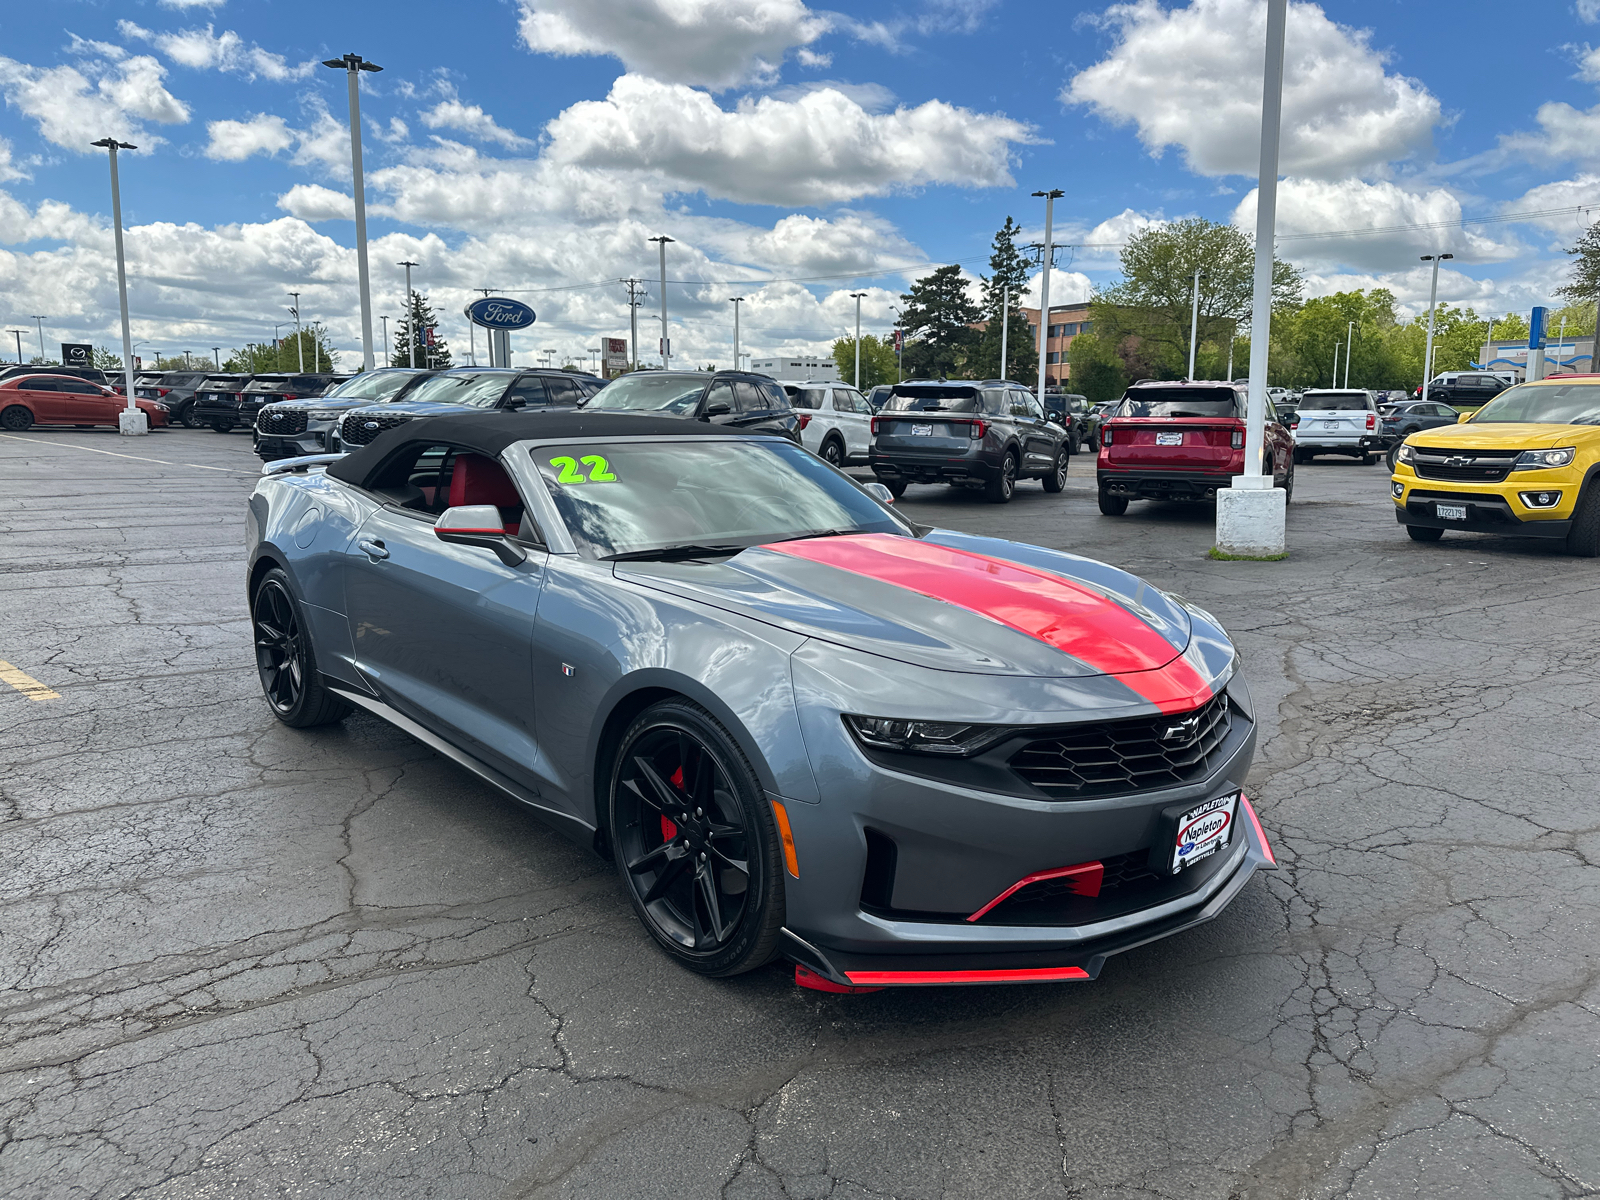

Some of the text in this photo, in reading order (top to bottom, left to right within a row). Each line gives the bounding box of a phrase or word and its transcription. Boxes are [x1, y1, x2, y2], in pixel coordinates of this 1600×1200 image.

[484, 303, 523, 323] Ford
[549, 455, 617, 484] 22
[1437, 507, 1462, 517] 1722179
[621, 717, 647, 751] EAGLE
[1192, 797, 1227, 818] NAPLETON
[1184, 819, 1222, 843] Napleton
[1186, 848, 1216, 867] LIBERTYVILLE
